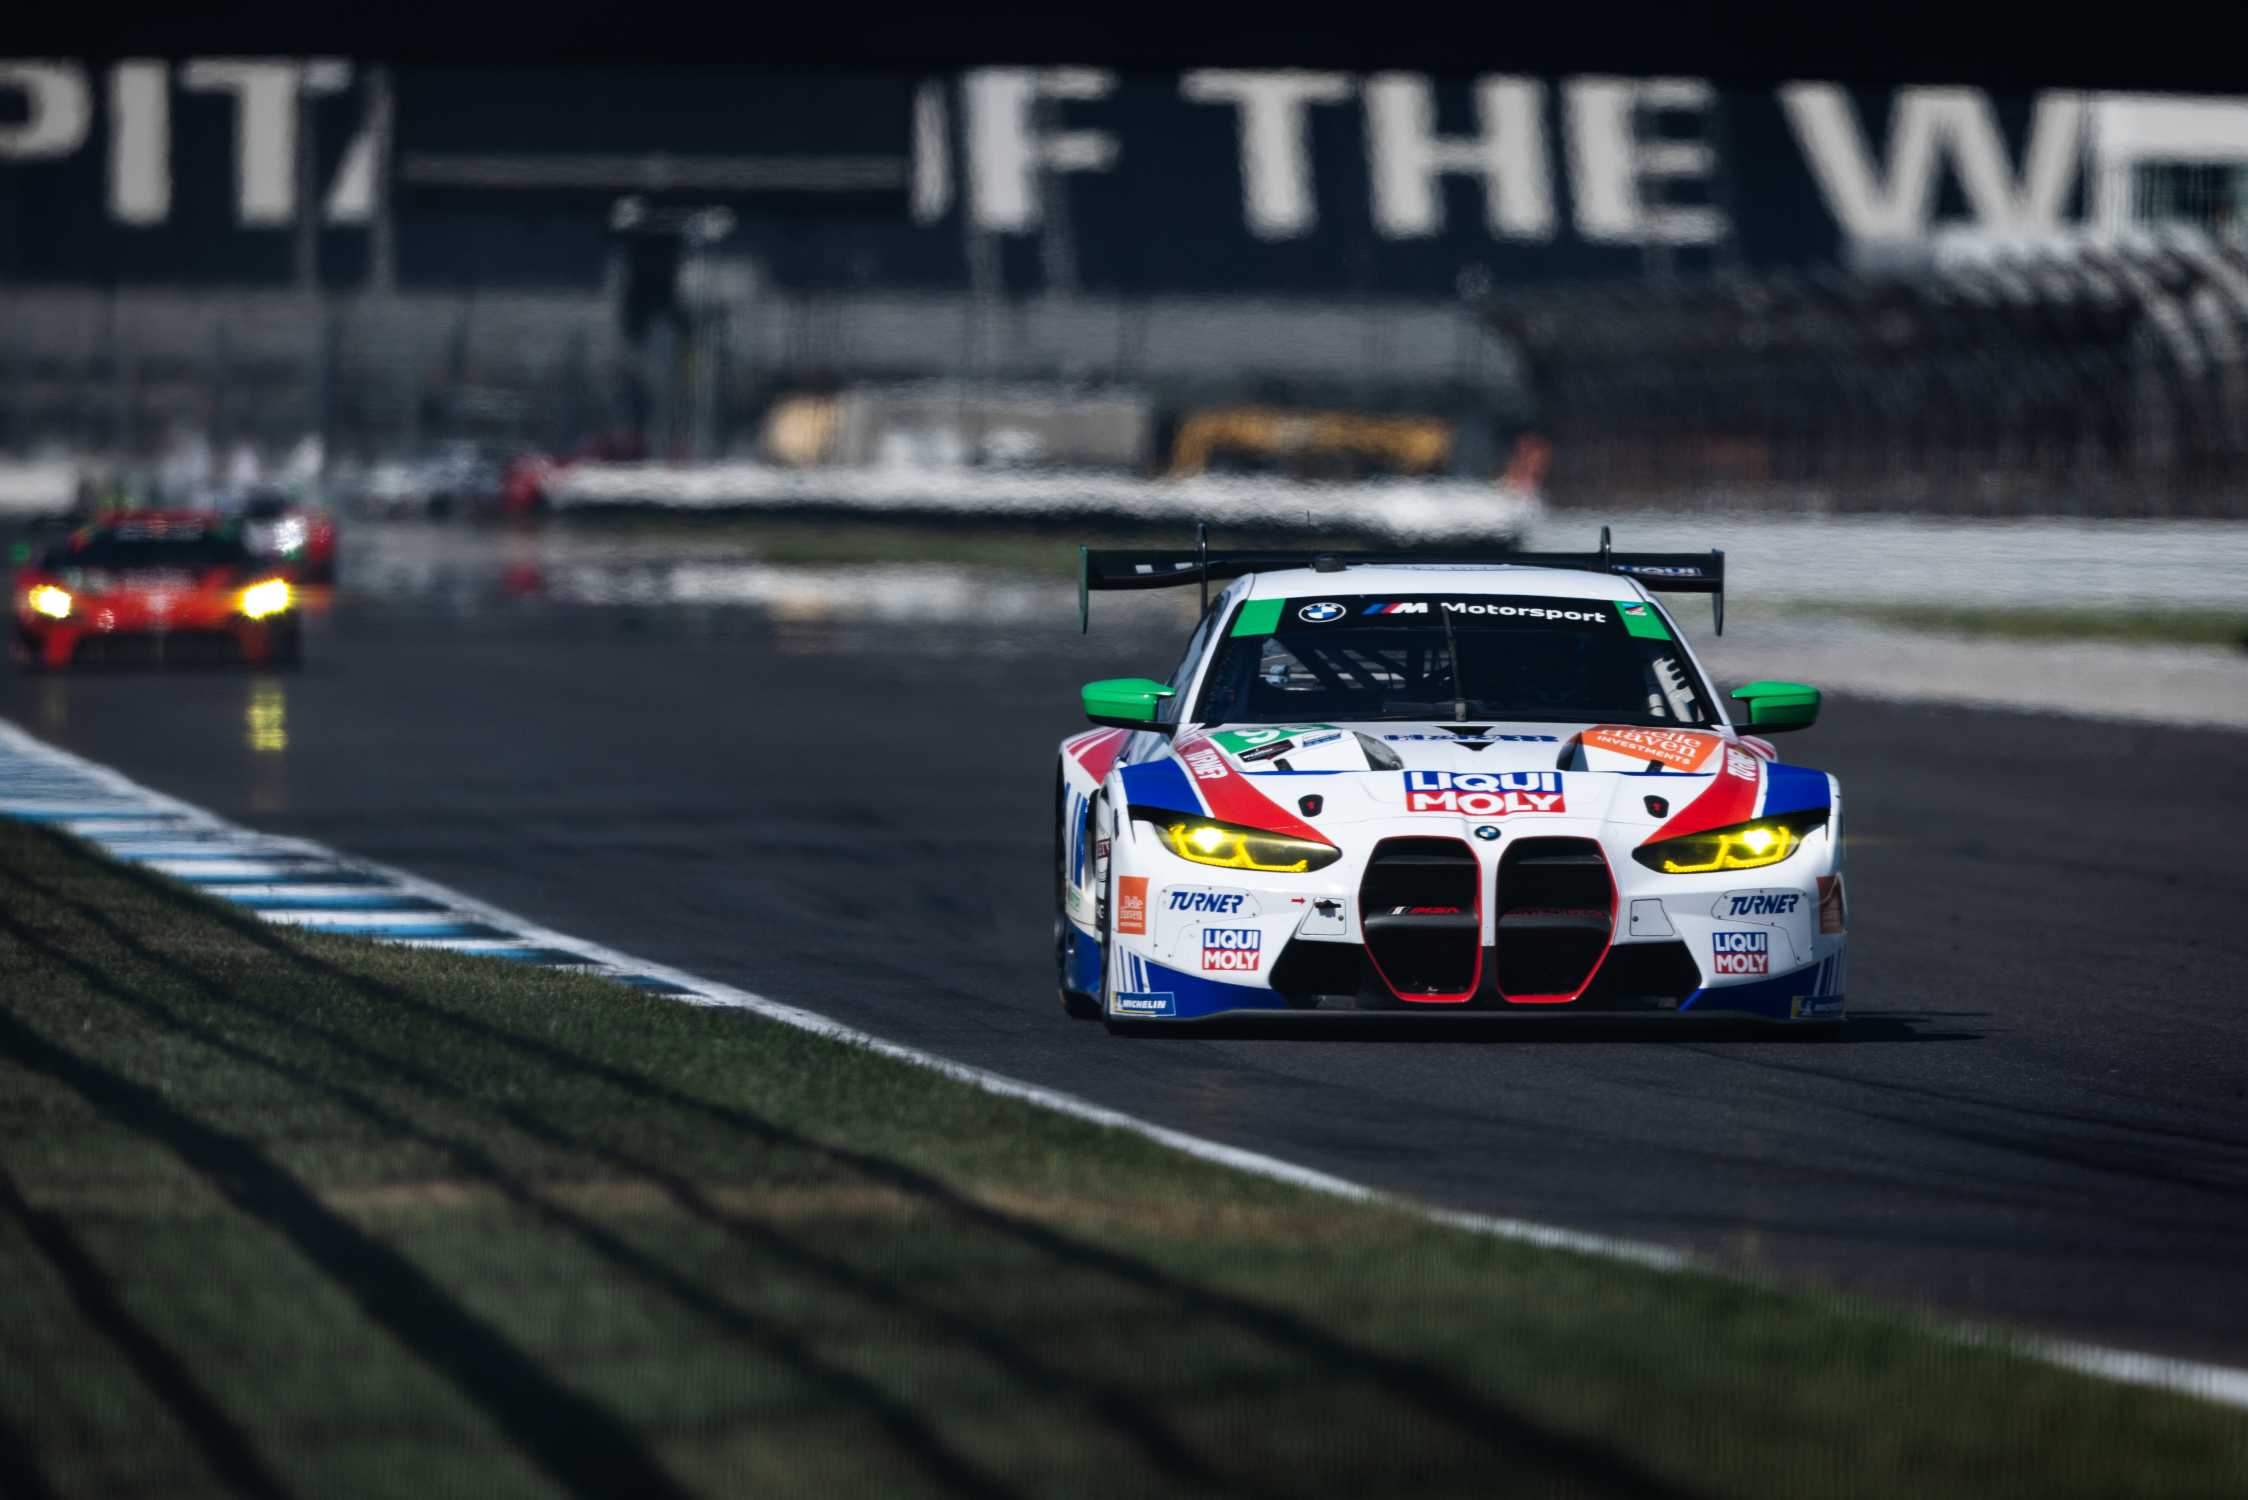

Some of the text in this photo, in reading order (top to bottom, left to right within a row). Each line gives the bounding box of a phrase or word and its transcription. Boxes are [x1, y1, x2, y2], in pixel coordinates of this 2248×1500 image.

[910, 66, 1120, 231] F
[1178, 66, 1732, 245] THE
[1440, 602, 1607, 622] Motorsport
[1596, 735, 1692, 764] INVESTMENTS
[1410, 771, 1556, 792] LIQUI
[1413, 791, 1561, 815] MOLY
[1168, 891, 1245, 914] TURNER
[1729, 894, 1800, 916] TURNER
[1204, 930, 1260, 950] LIQUI
[1715, 933, 1766, 953] LIQUI
[1203, 951, 1260, 969] MOLY
[1715, 953, 1768, 973] MOLY
[1122, 999, 1168, 1009] MICHELIN
